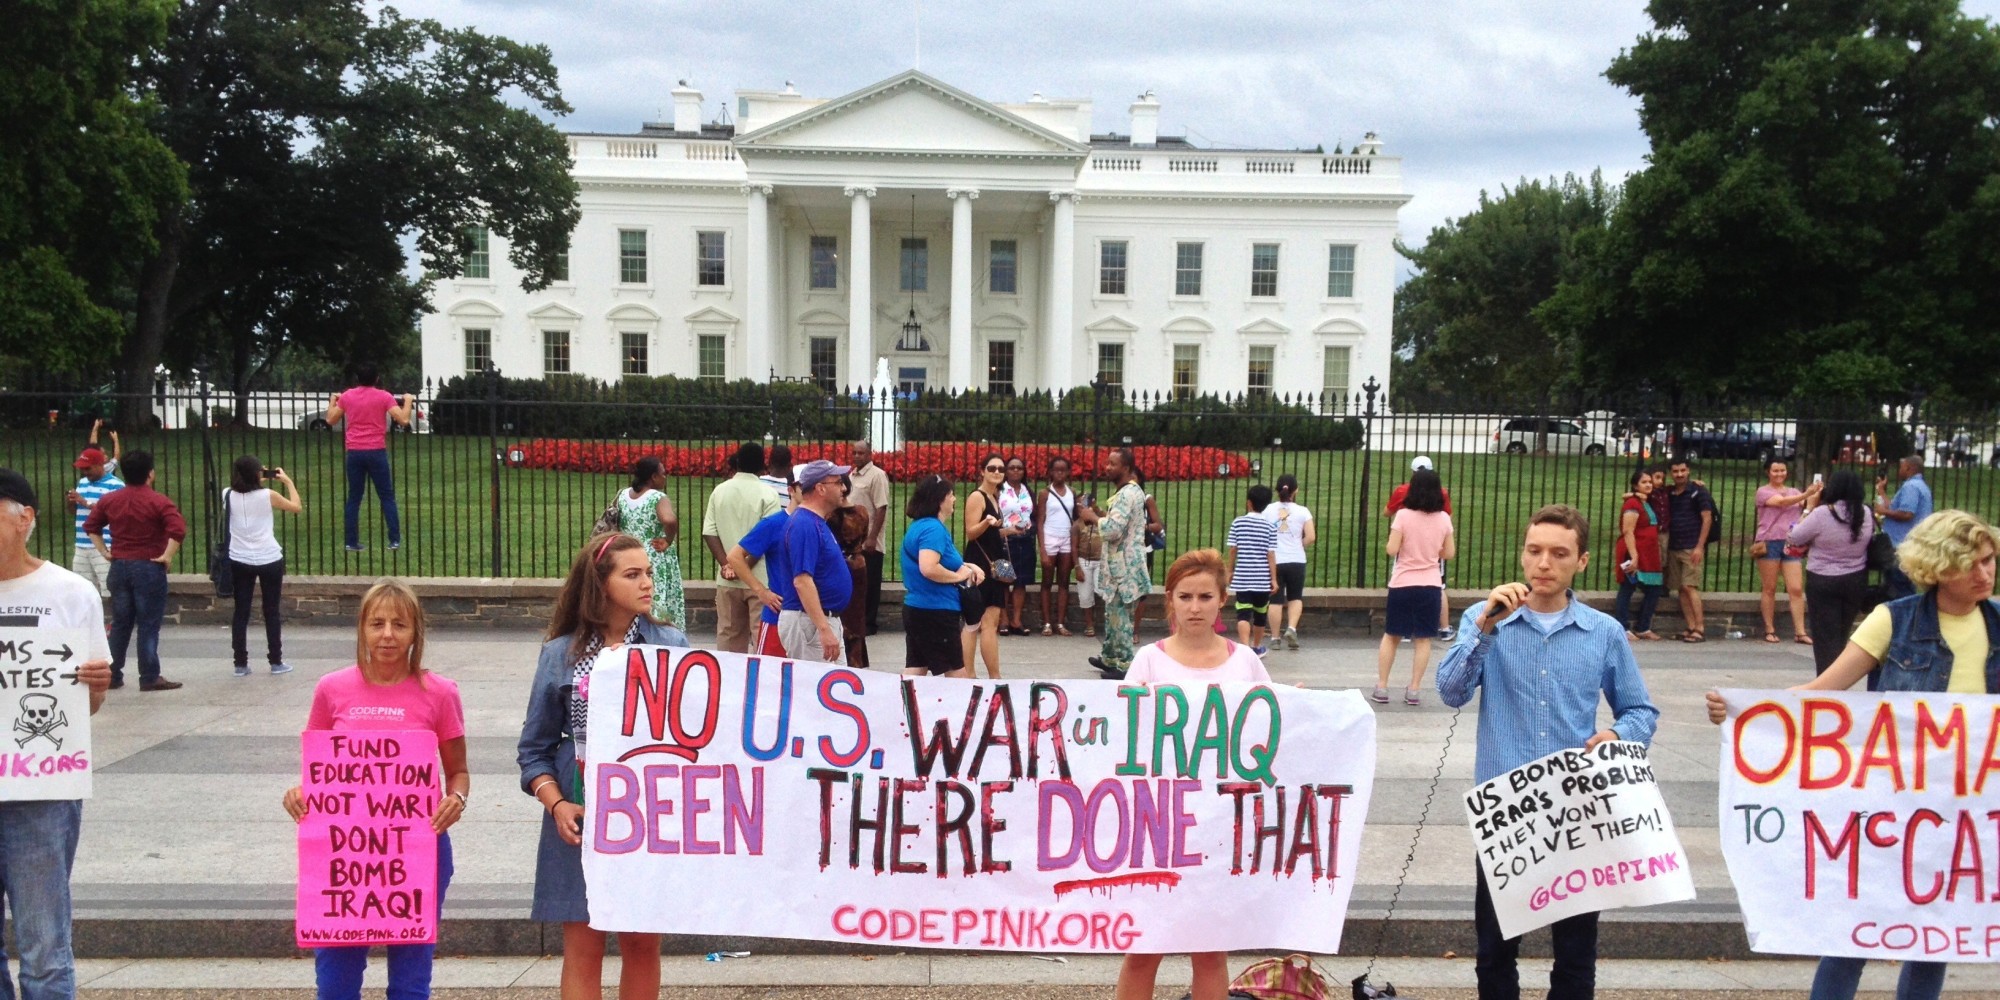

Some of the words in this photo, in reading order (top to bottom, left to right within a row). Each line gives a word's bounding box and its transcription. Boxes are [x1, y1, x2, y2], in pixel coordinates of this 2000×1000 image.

[349, 706, 405, 716] CODEPINK
[621, 647, 721, 750] NO
[741, 656, 884, 769] U.S.
[901, 681, 1073, 784] WAR
[1072, 704, 1109, 746] in
[1115, 683, 1281, 788] IRAQ
[330, 735, 400, 759] FUND
[309, 761, 436, 790] EDUCATION,
[1466, 782, 1502, 816] US
[1509, 750, 1594, 794] BOMBS
[305, 792, 356, 815] NOT
[593, 762, 764, 855] BEEN
[806, 766, 1015, 879] THERE
[1036, 777, 1203, 874] DONE
[1216, 781, 1353, 885] THAT
[1475, 788, 1554, 840] IRAQ'S
[1561, 764, 1655, 796] PROBLEMS
[1483, 818, 1536, 861] THEY
[1546, 793, 1617, 829] WON'T
[1733, 804, 1785, 844] TO
[1493, 826, 1586, 890] SOLVE
[1591, 807, 1664, 842] THEM!
[329, 857, 407, 888] BOMB
[321, 888, 423, 924] IRAQ!
[831, 904, 1141, 950] CODEPINK.ORG
